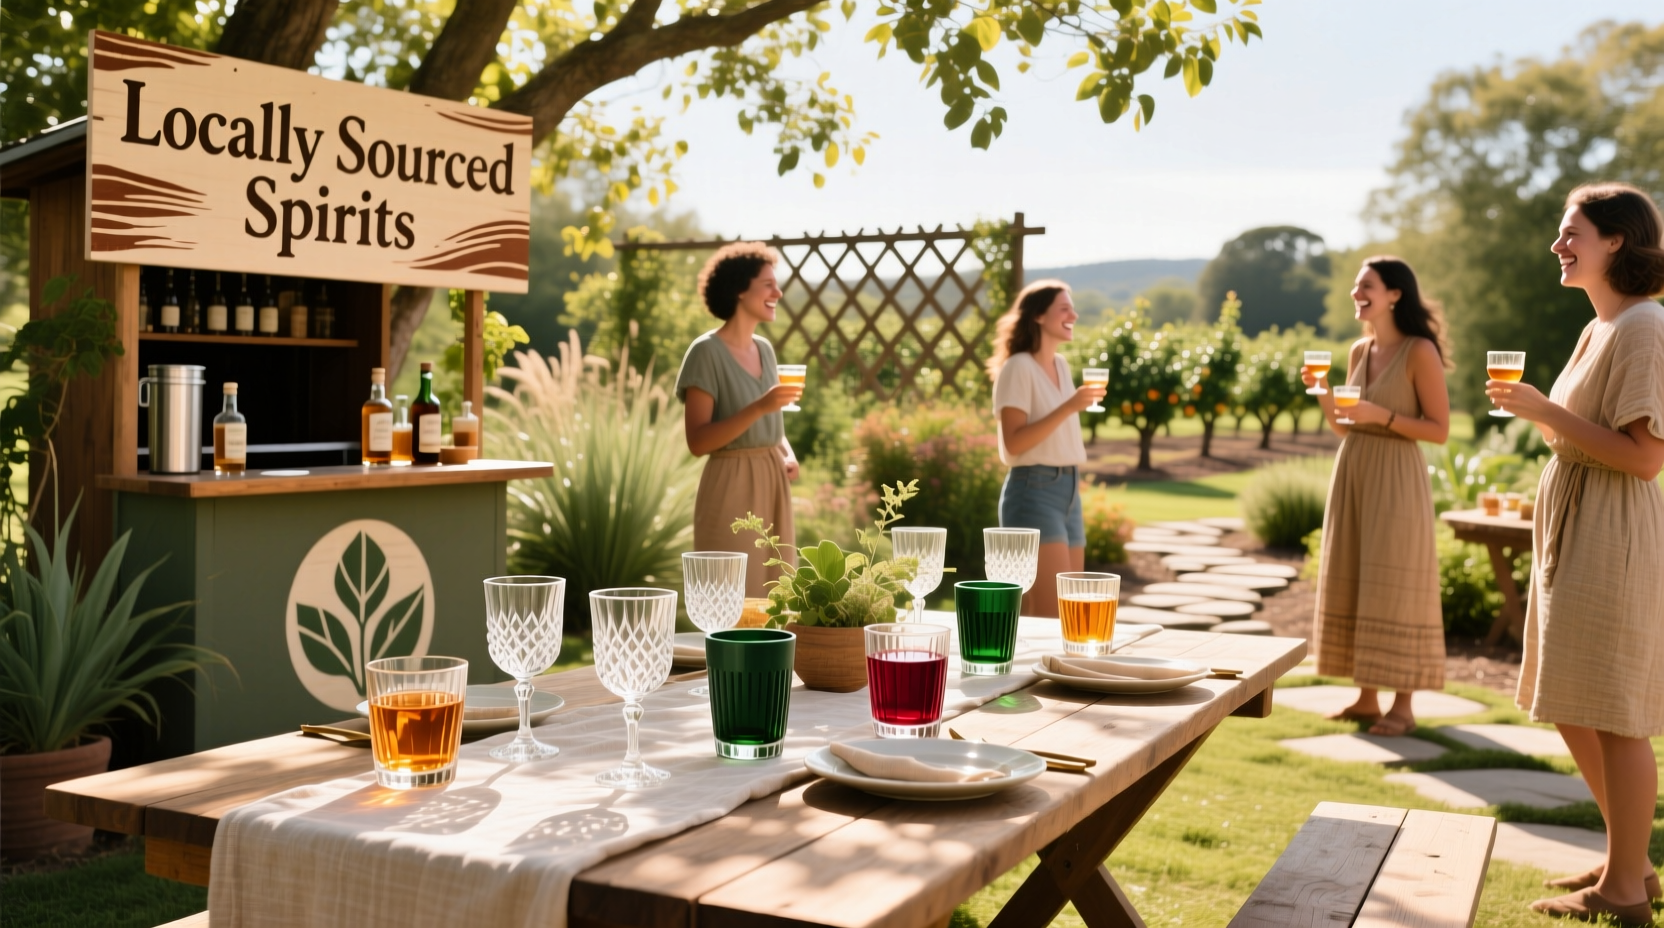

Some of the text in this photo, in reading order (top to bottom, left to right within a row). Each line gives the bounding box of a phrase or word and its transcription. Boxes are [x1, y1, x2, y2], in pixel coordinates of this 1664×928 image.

[120, 78, 515, 195] Locally Sourced
[244, 175, 415, 258] Spirits
